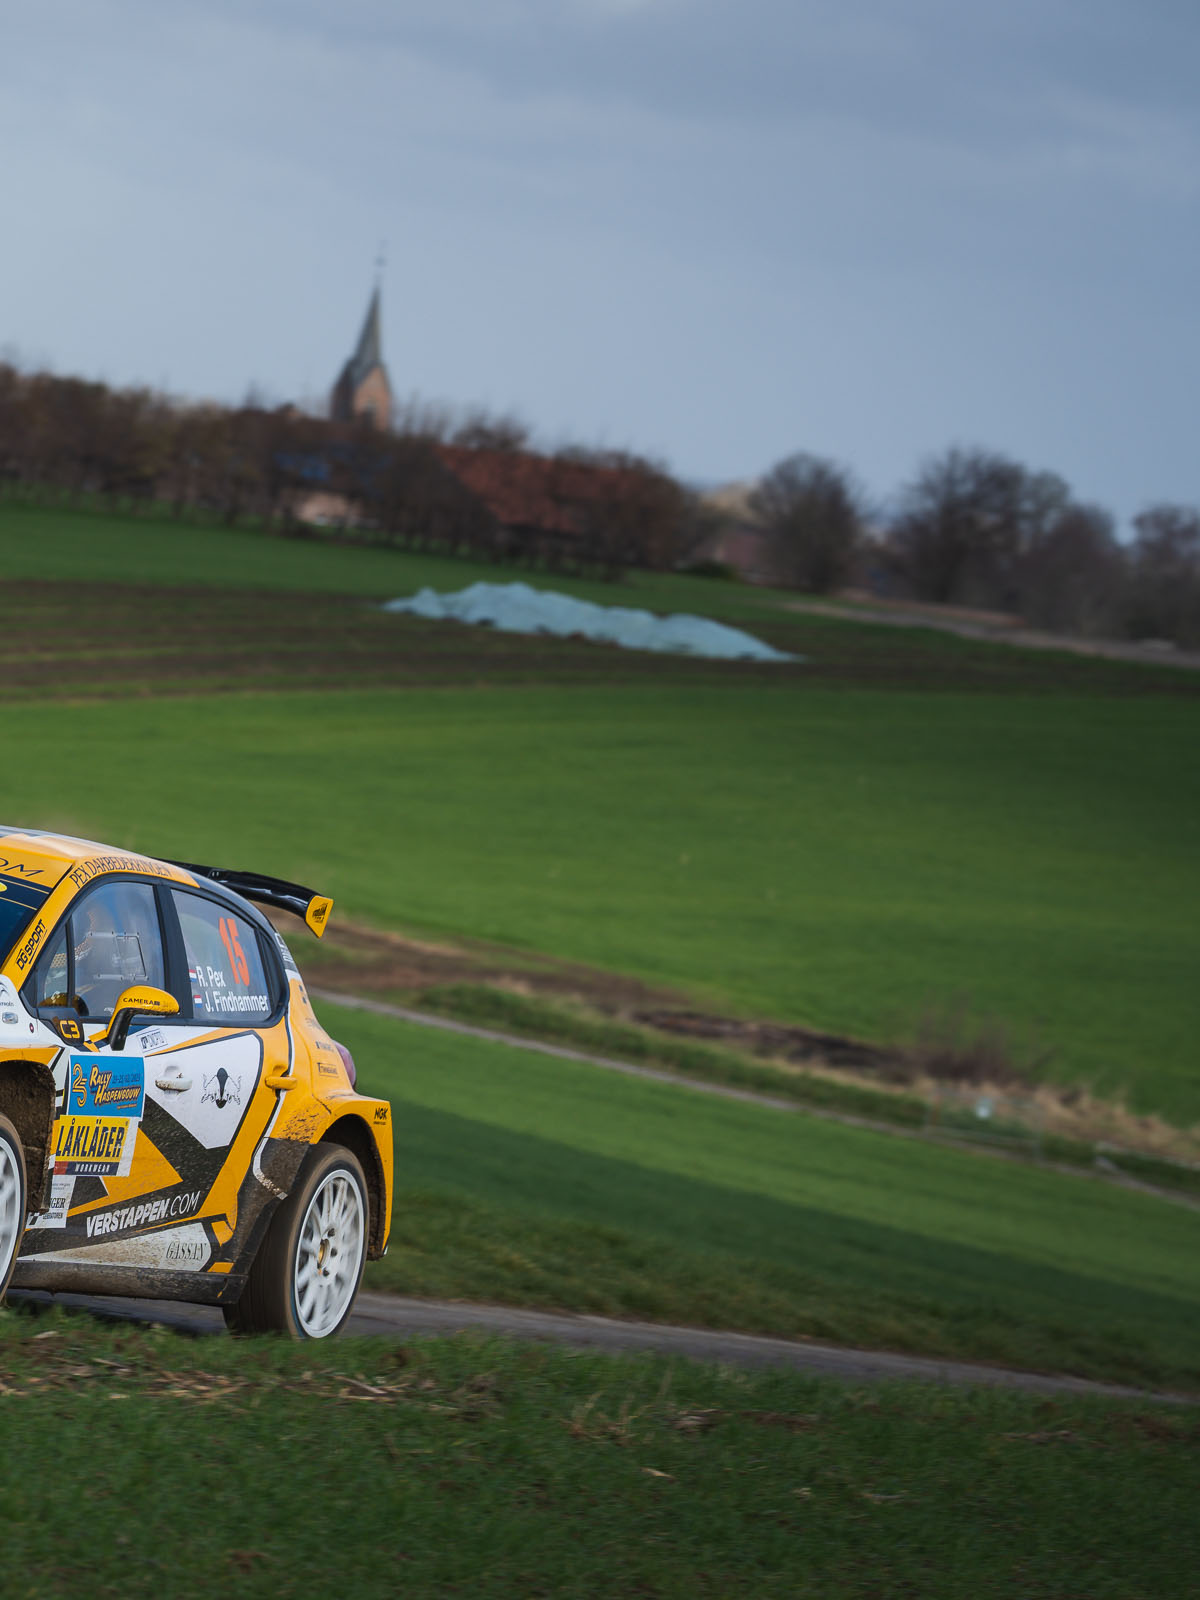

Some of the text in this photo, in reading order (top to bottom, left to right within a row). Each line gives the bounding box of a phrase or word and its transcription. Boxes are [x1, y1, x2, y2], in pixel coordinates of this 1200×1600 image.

[69, 865, 91, 888] PEX
[218, 916, 250, 987] 15
[196, 966, 227, 987] R. Pex
[212, 991, 269, 1012] Findhammer
[86, 1191, 200, 1237] VERSTAPPEN.COM
